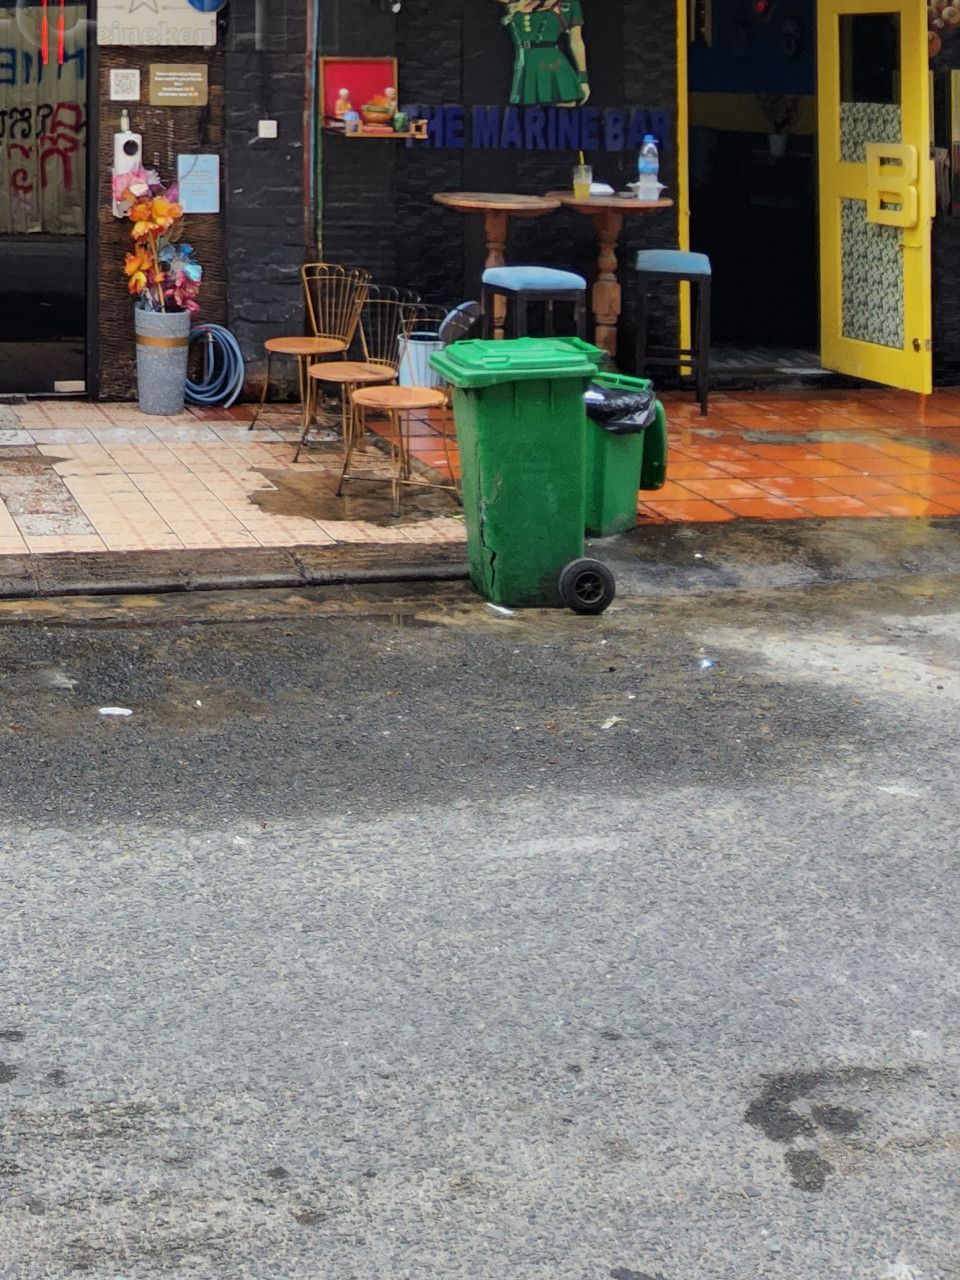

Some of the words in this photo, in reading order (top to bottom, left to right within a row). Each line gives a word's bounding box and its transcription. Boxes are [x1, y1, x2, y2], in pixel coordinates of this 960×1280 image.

[405, 104, 465, 148] THE
[472, 104, 598, 150] MARINE
[604, 106, 673, 153] BAR
